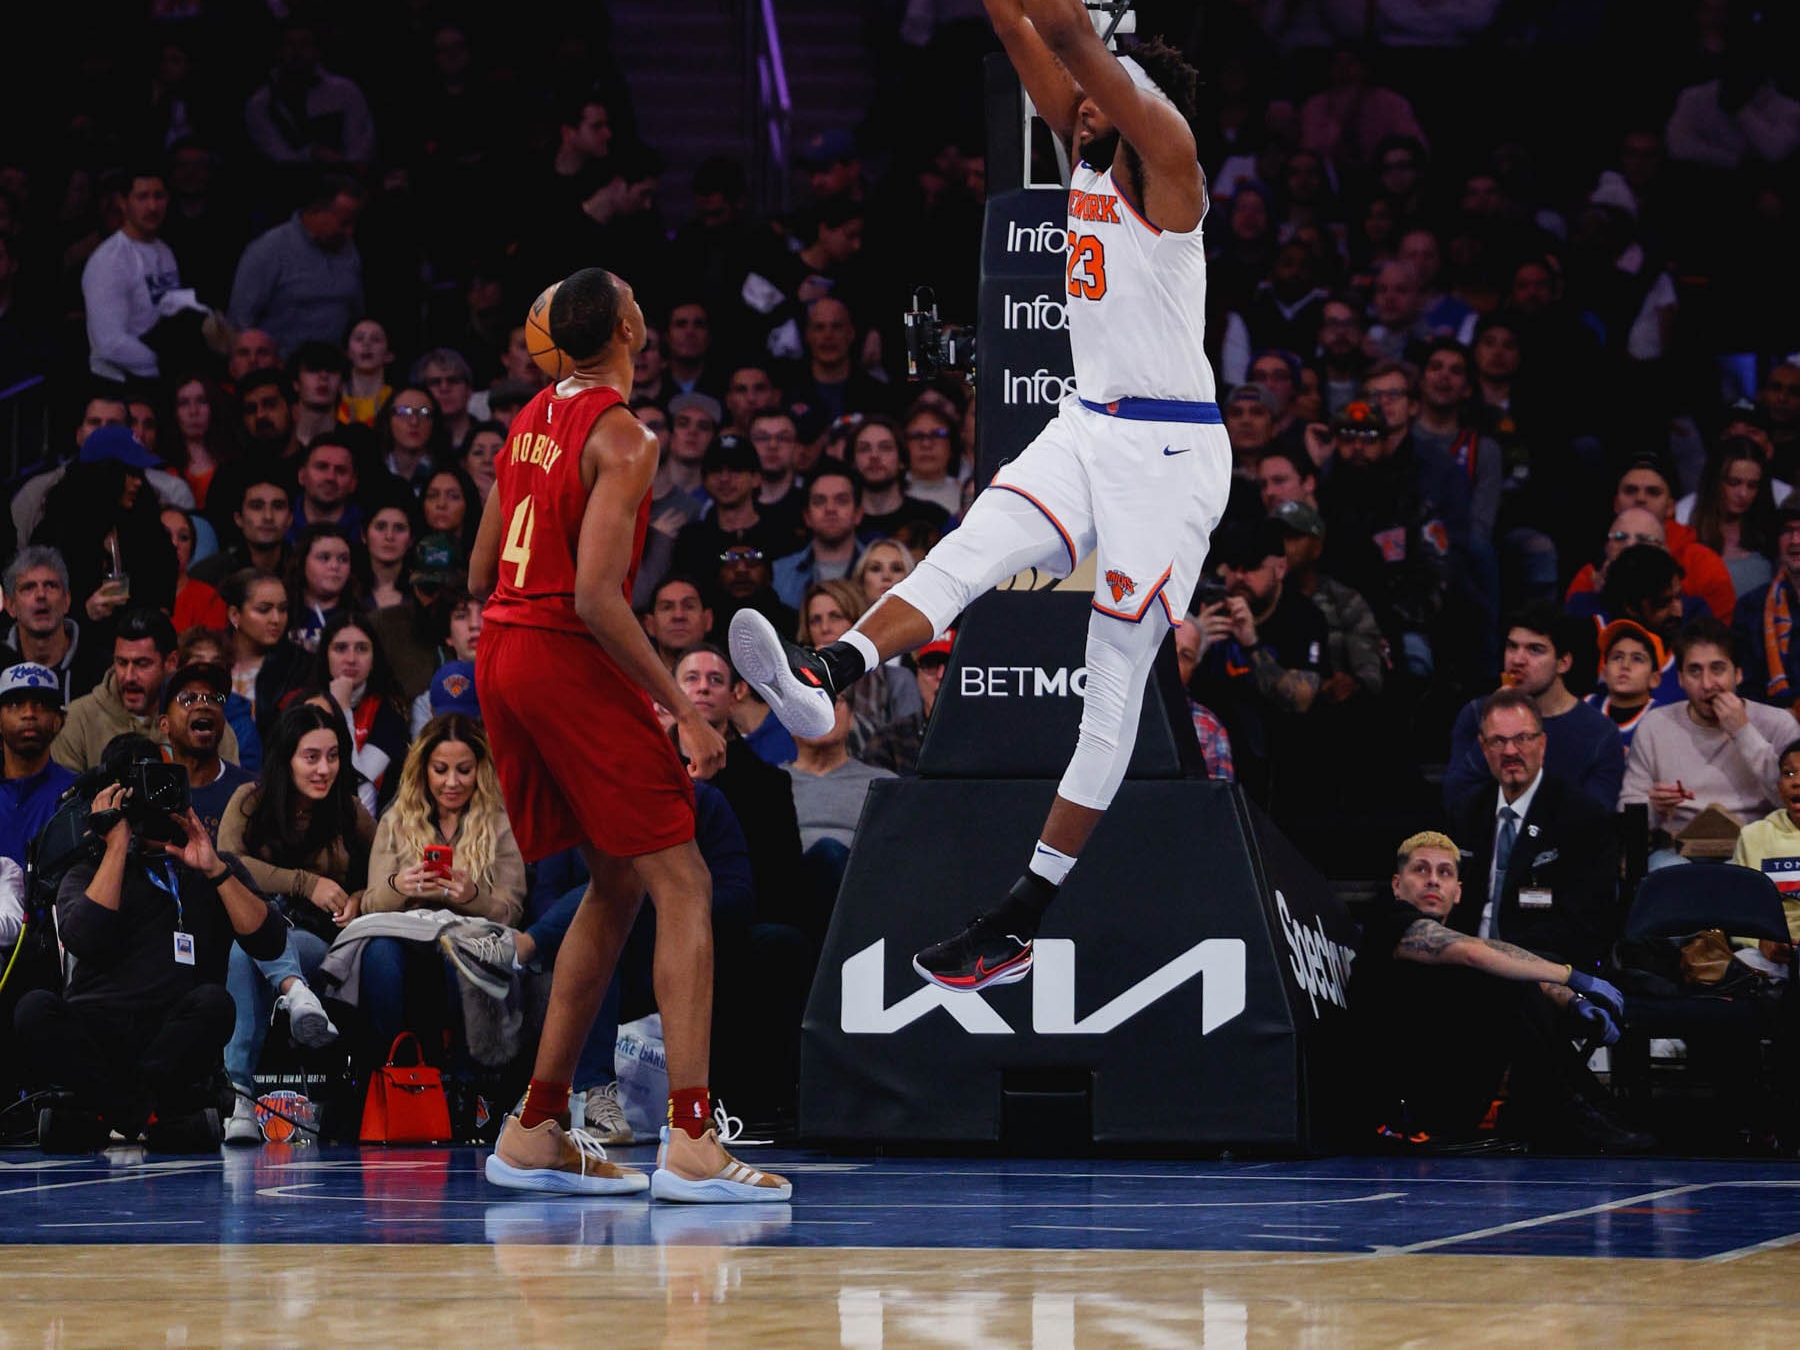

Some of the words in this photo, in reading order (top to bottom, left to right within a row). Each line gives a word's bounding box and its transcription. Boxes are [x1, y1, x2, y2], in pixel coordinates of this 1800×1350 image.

[1007, 221, 1068, 254] Info
[1067, 230, 1108, 301] 23
[501, 493, 535, 589] 4
